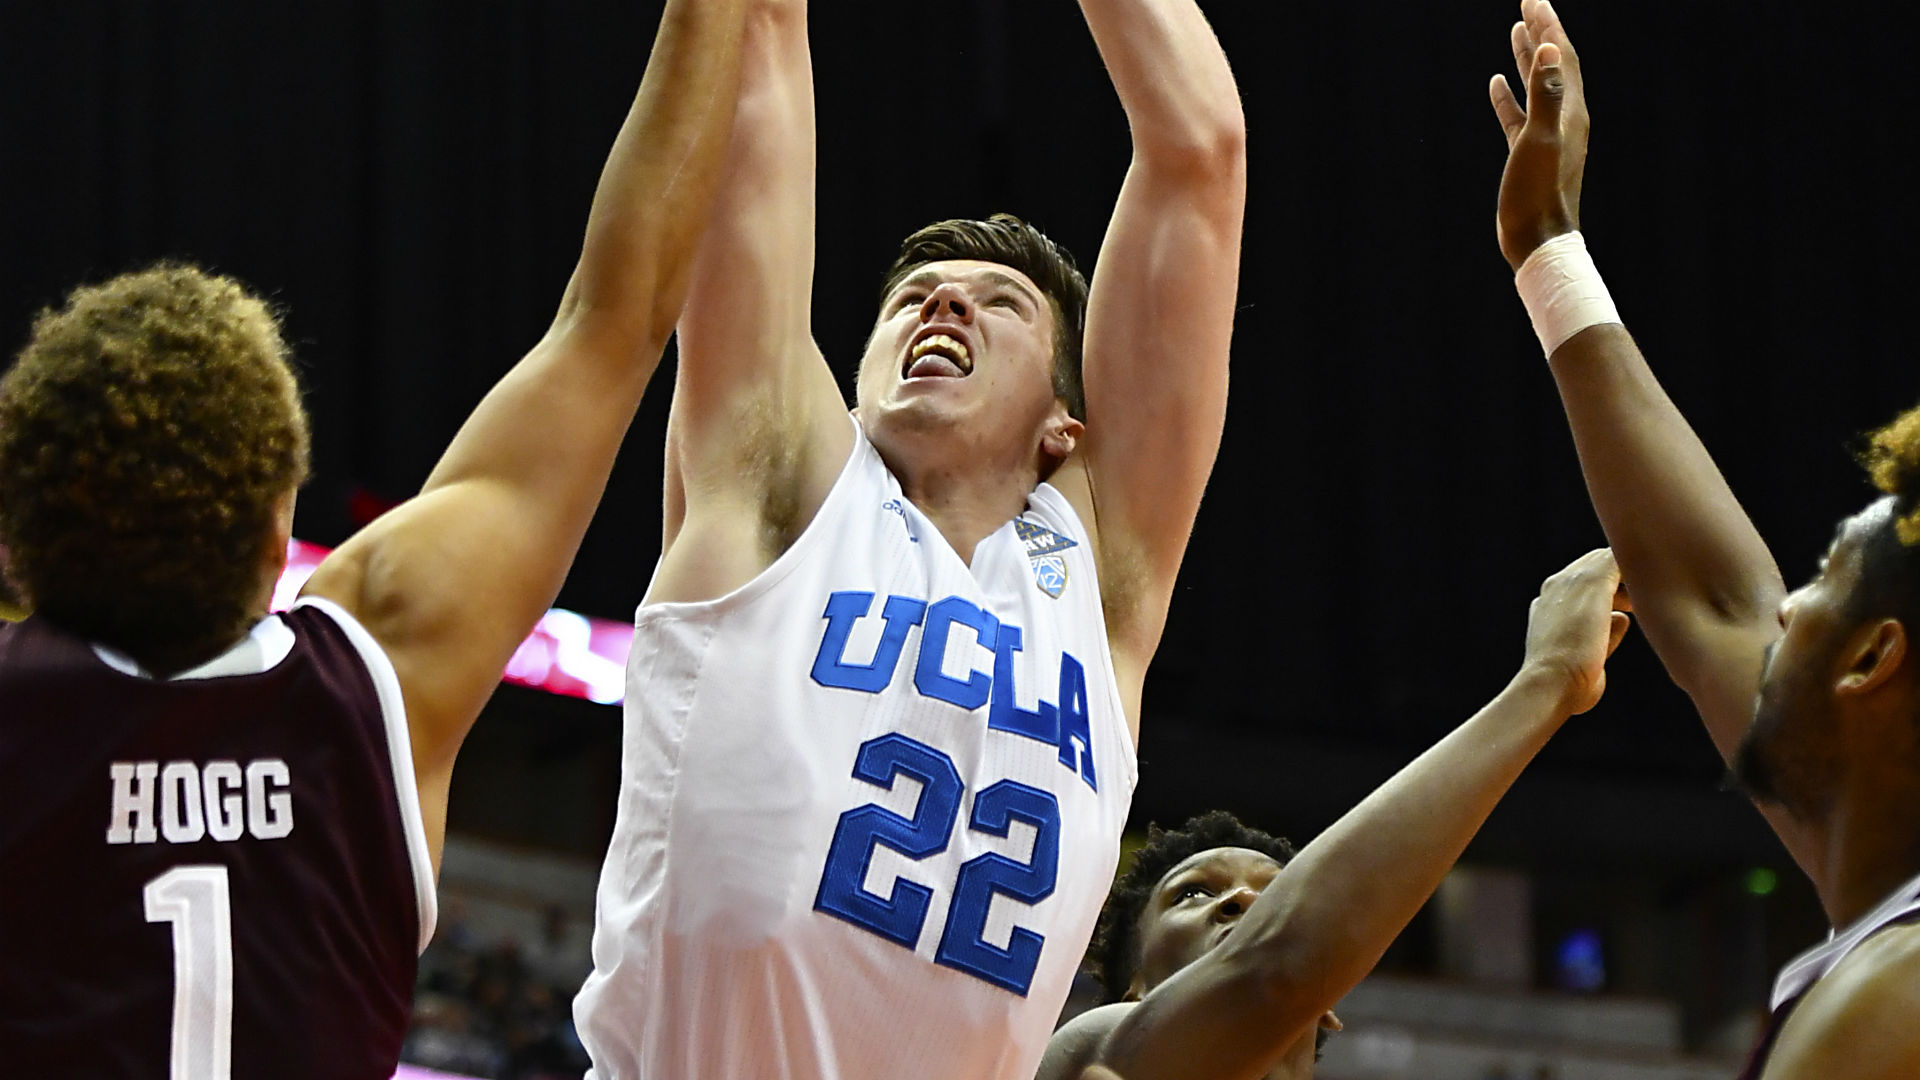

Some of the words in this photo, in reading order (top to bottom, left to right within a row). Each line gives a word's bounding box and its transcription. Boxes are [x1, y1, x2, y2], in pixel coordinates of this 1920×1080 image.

[811, 591, 1098, 793] UCLA
[106, 761, 294, 844] HOGG
[813, 732, 1061, 998] 22
[143, 865, 233, 1080] 1
